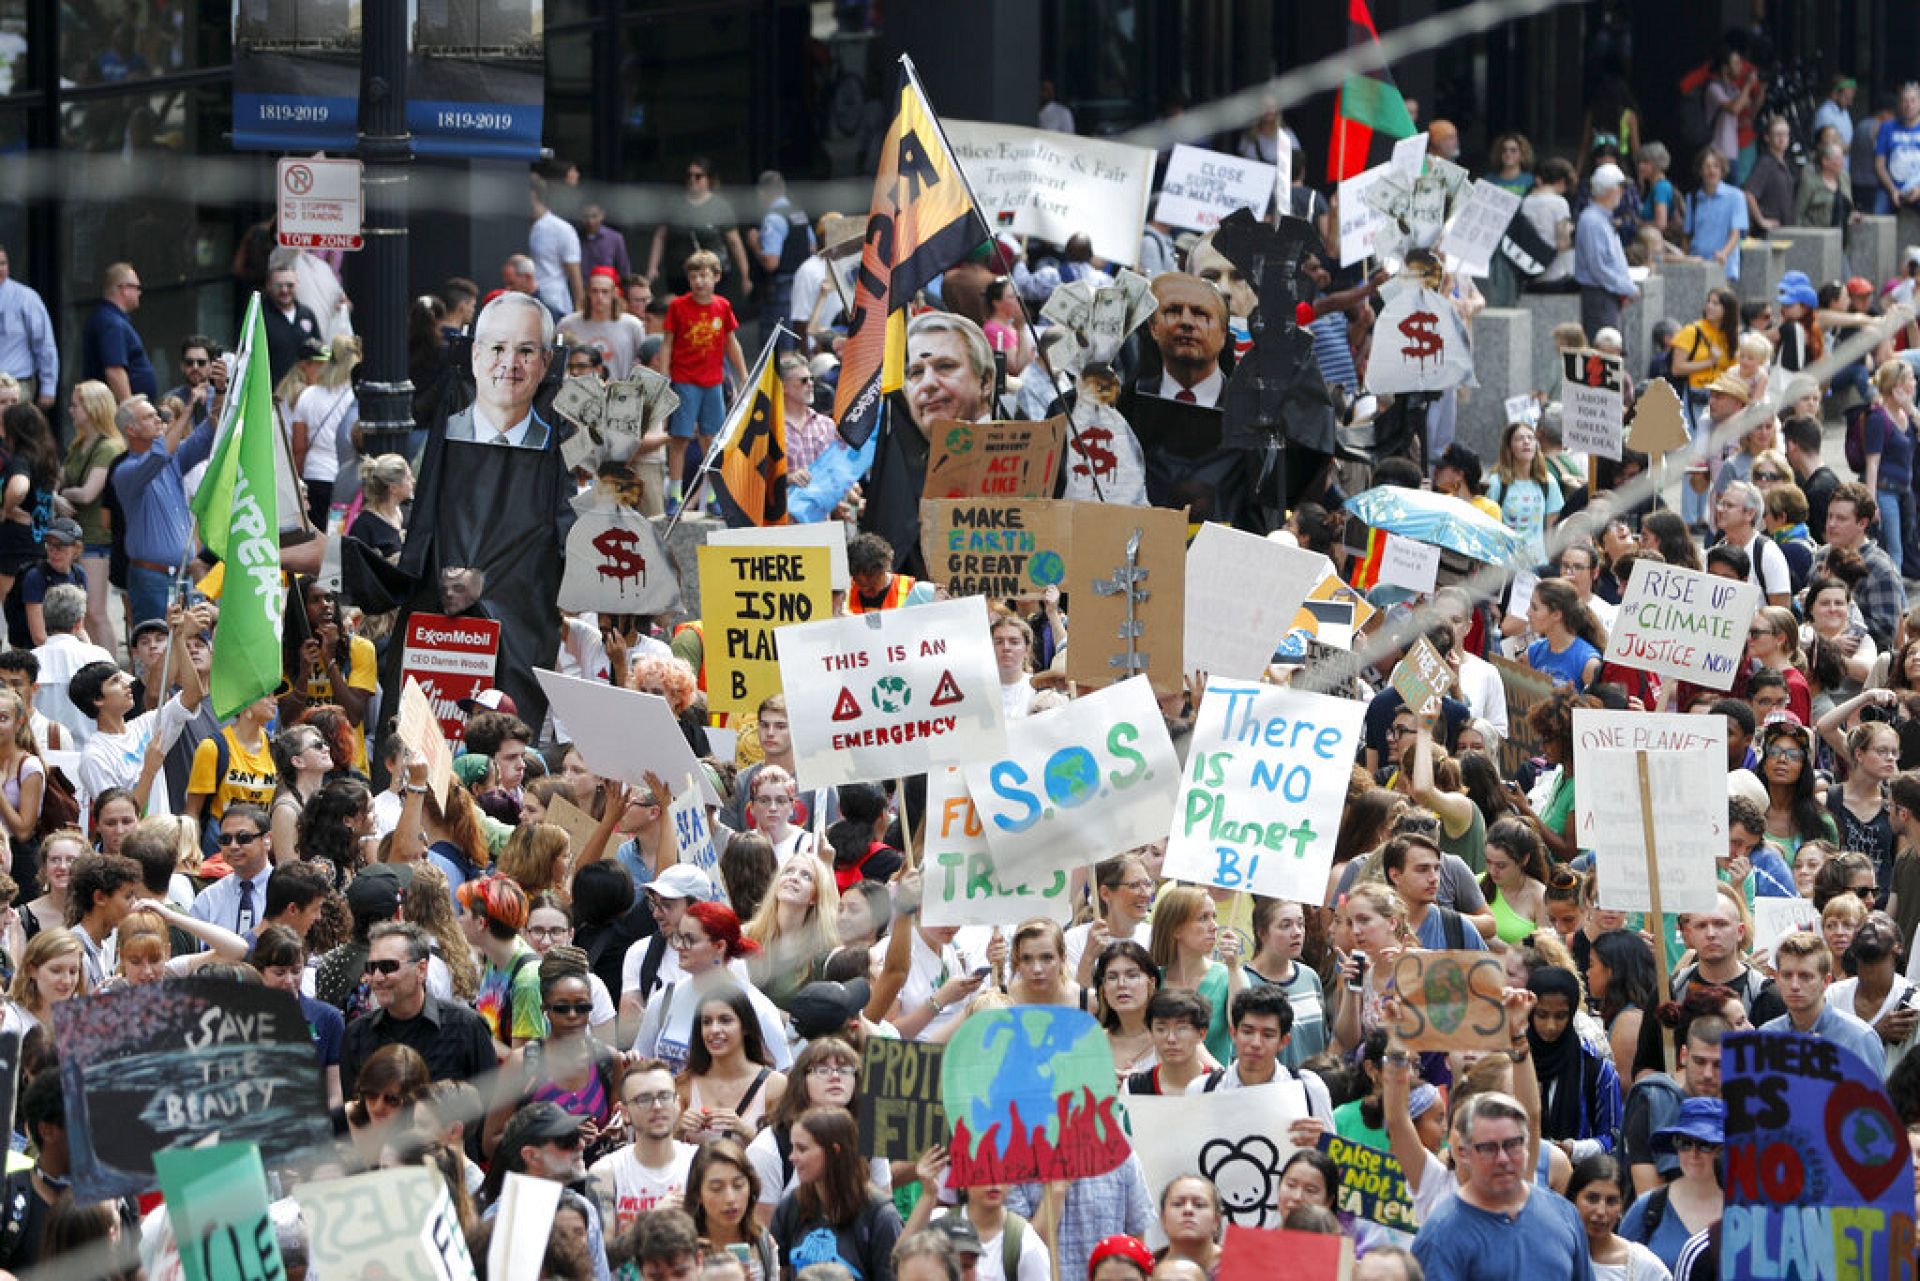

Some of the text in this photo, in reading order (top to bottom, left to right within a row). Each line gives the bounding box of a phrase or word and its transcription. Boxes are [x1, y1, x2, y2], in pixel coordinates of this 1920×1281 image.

[259, 104, 329, 121] 1819-2019
[438, 111, 513, 129] 1819-2019
[1071, 154, 1086, 174] &
[286, 234, 352, 248] TOW ZONE
[987, 456, 1021, 473] ACT
[981, 476, 1019, 494] LIKE
[952, 507, 1024, 529] MAKE
[948, 529, 1035, 552] EARTH
[730, 554, 805, 582] THERE
[947, 553, 1028, 575] GREAT
[1711, 584, 1737, 610] UP
[1638, 603, 1735, 640] CLIMATE
[416, 627, 491, 645] ExxonMobil
[410, 653, 489, 669] CEO Darren Woods
[821, 638, 946, 672] THIS IS AN
[1702, 652, 1736, 674] NOW
[732, 671, 747, 699] B
[832, 716, 957, 750] EMERGENCY
[1207, 687, 1343, 759] There
[1581, 727, 1626, 749] ONE
[229, 768, 257, 784] SAY
[1250, 759, 1312, 803] NO
[1185, 788, 1319, 858] Planet
[1213, 847, 1257, 890] B!
[184, 1004, 278, 1052] SAVE
[199, 1050, 262, 1083] THE
[1722, 1036, 1843, 1081] THERE
[165, 1079, 279, 1130] BEAUTY
[1722, 1075, 1789, 1135] IS
[1726, 1141, 1805, 1203] NO
[1721, 1205, 1885, 1281] PLANET
